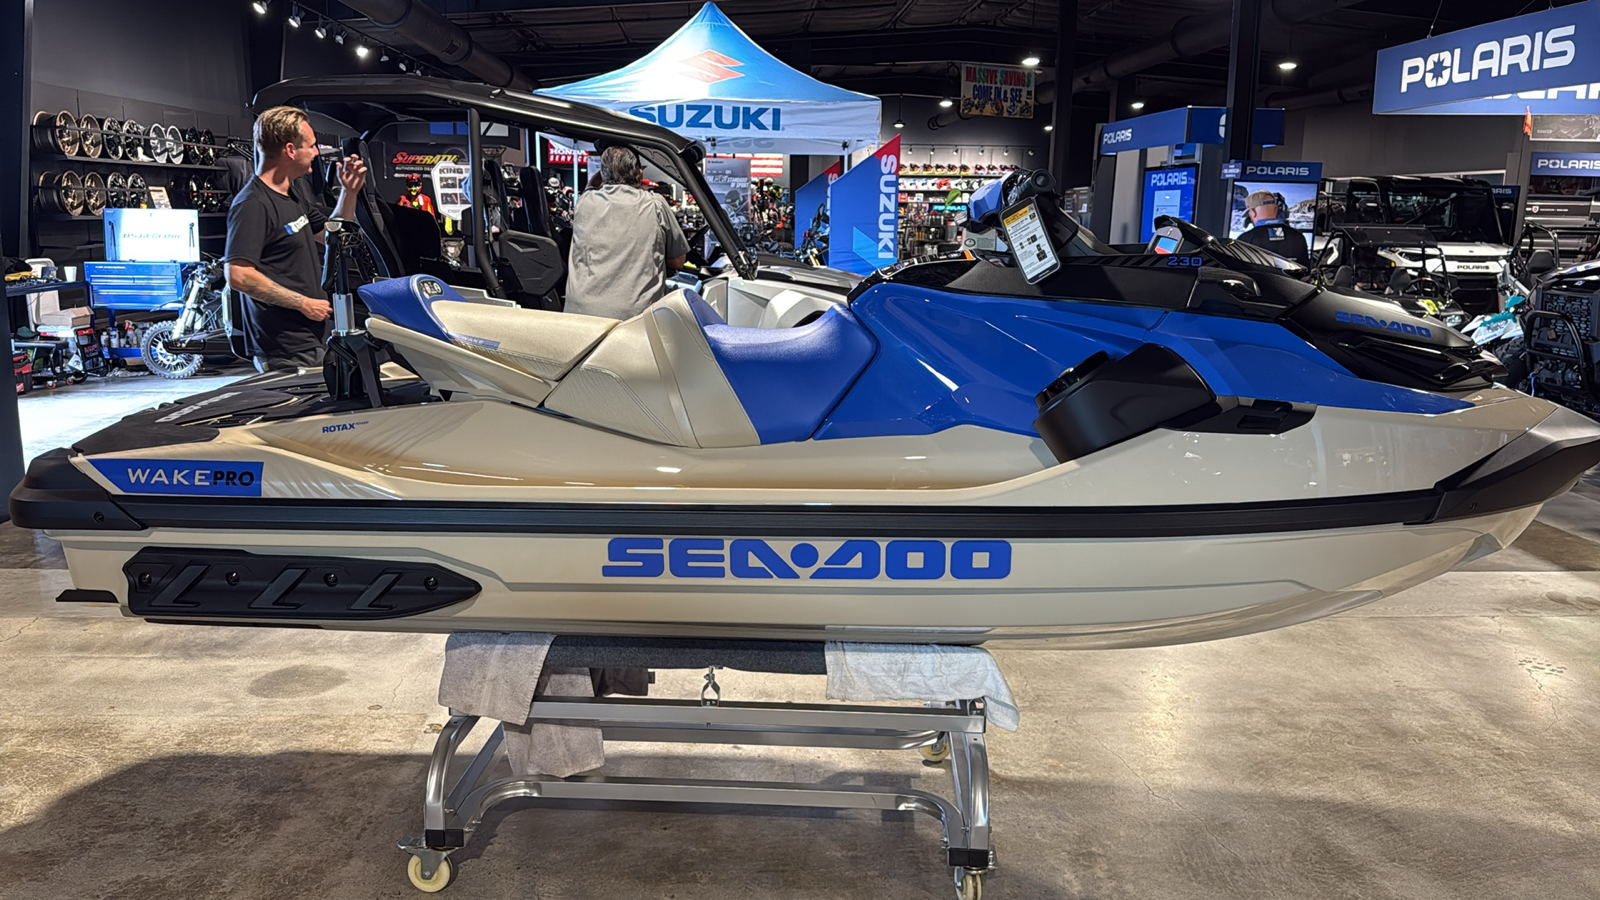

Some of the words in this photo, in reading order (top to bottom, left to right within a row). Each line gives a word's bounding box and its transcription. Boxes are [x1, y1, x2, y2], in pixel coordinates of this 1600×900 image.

[1400, 24, 1576, 93] POLARIS
[972, 84, 993, 101] COME
[1003, 89, 1009, 102] &
[1010, 87, 1023, 104] SEE
[629, 104, 781, 131] SUZUKI
[1103, 128, 1132, 145] POLARIS
[1246, 166, 1309, 176] POLARIS
[1537, 159, 1600, 170] POLARIS
[1151, 172, 1187, 187] POLARIS
[878, 154, 898, 259] SUZUKI
[1168, 256, 1202, 266] 230
[322, 422, 355, 434] ROTAX
